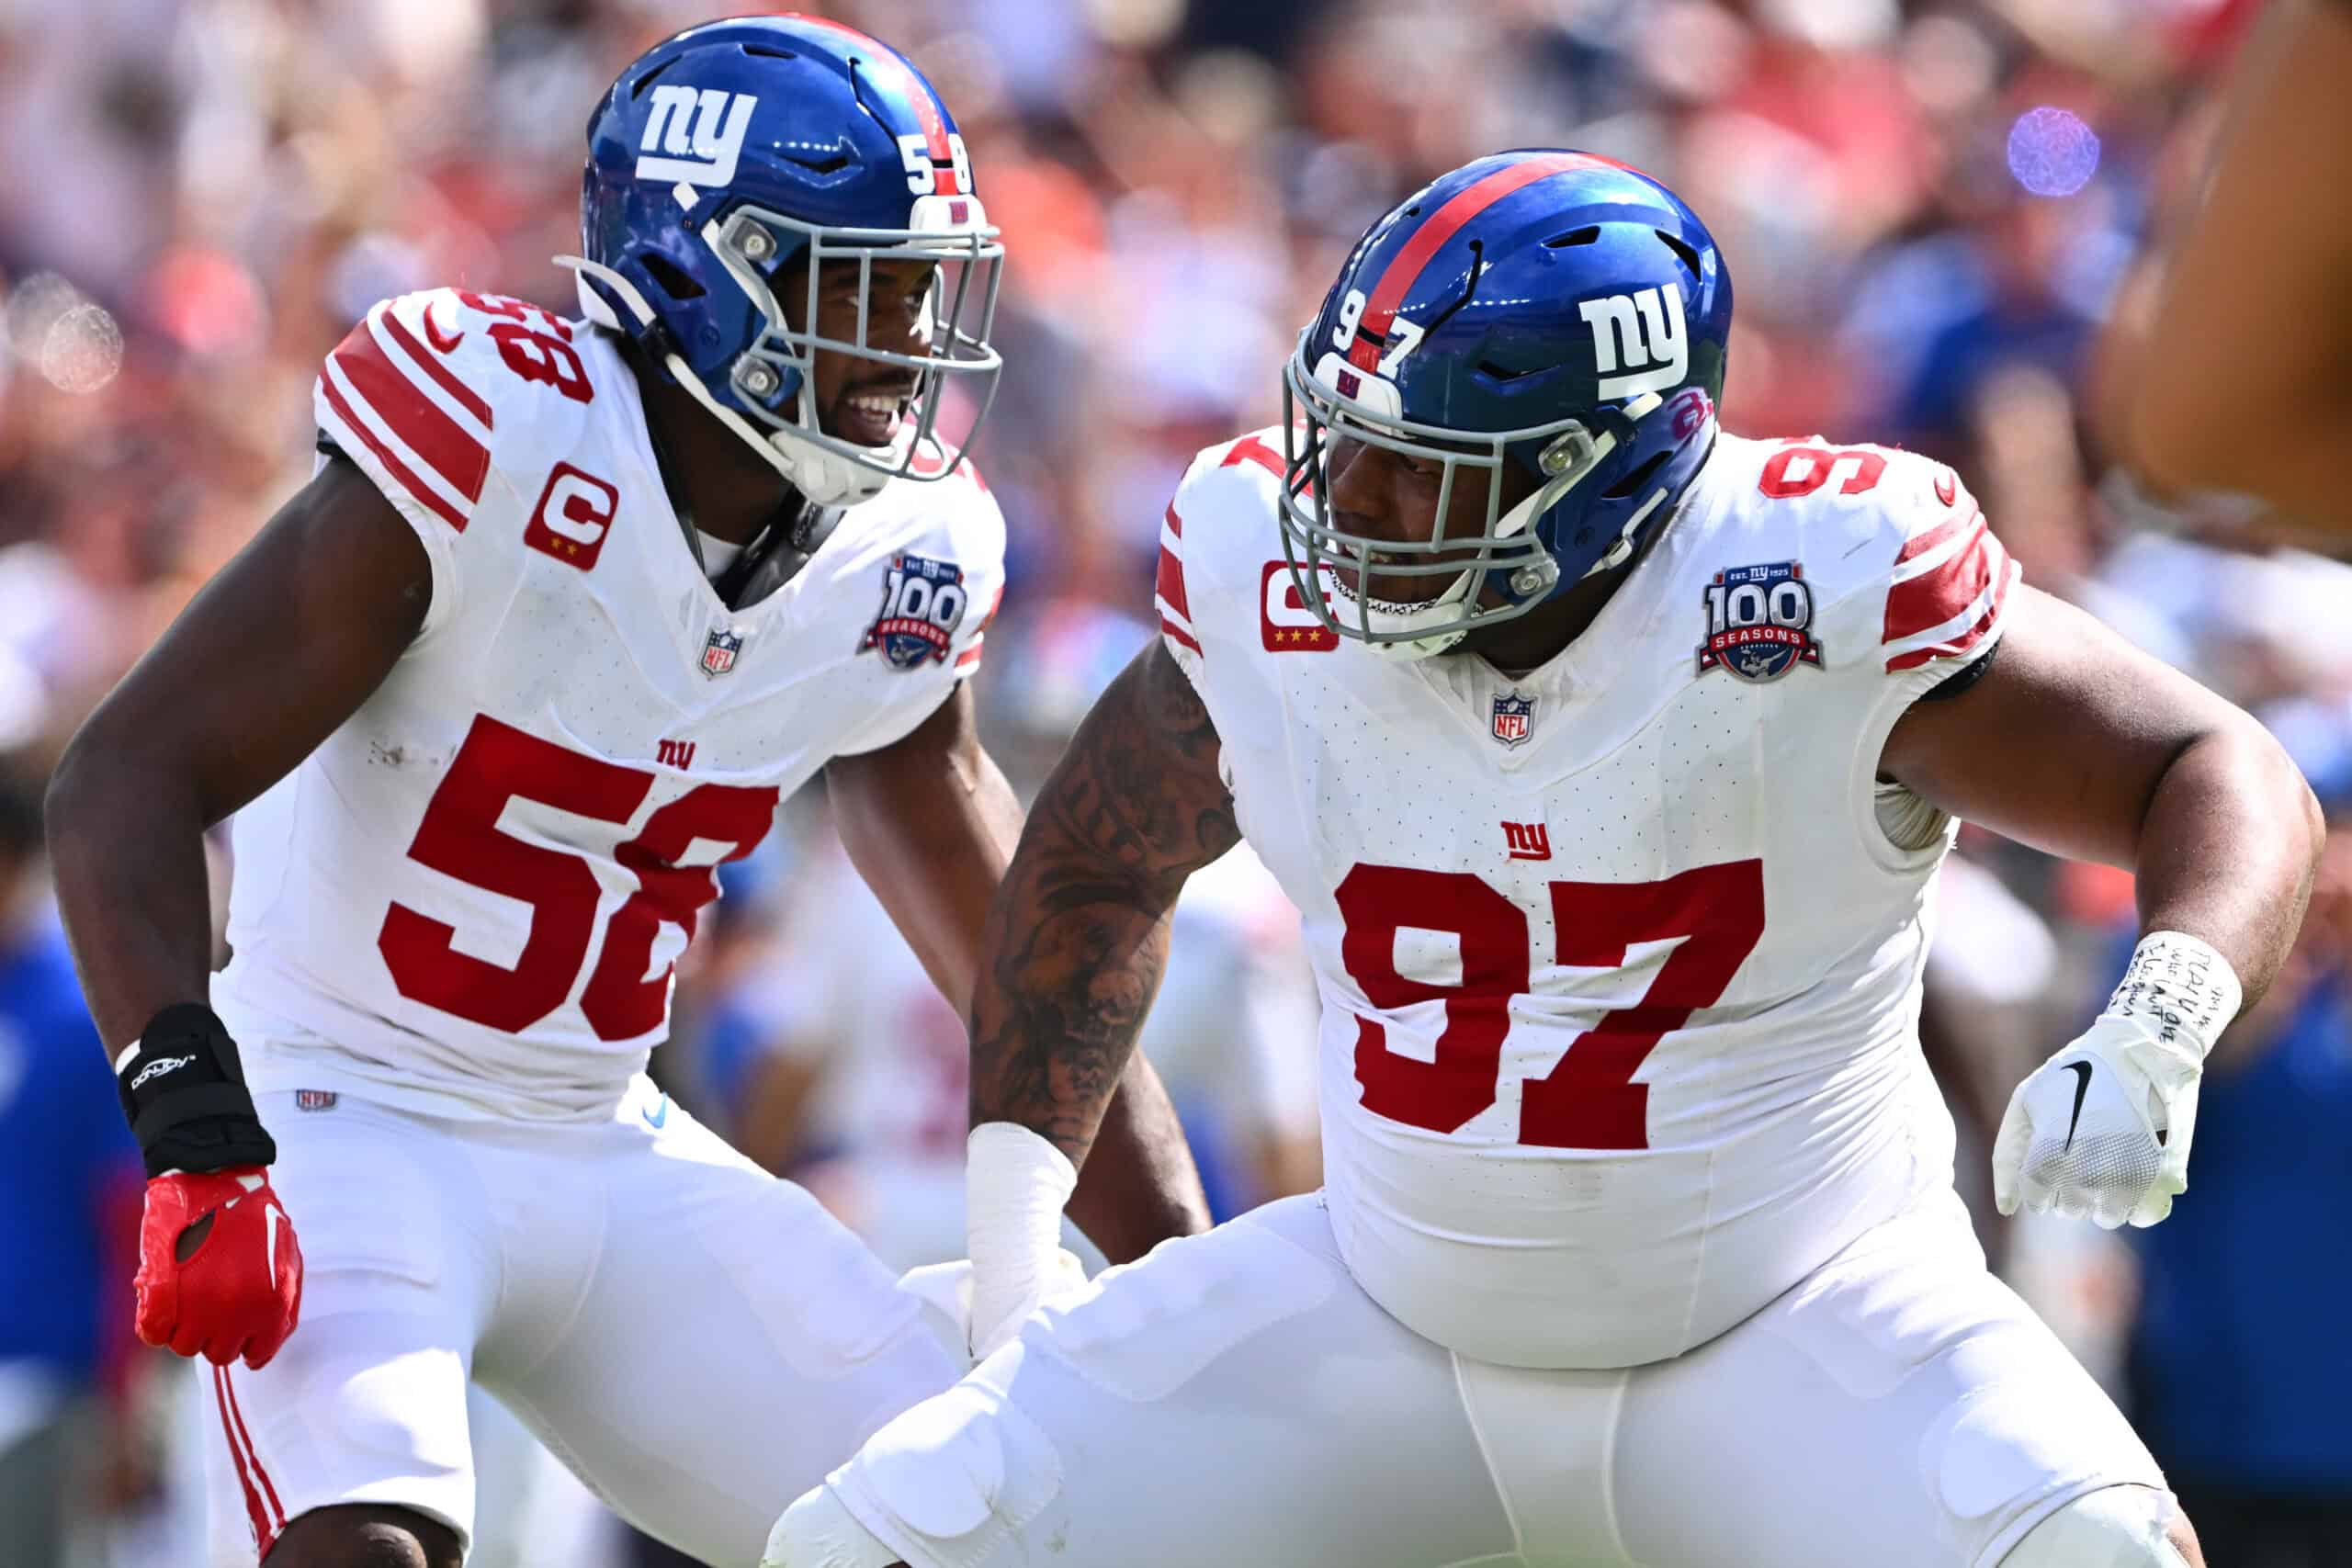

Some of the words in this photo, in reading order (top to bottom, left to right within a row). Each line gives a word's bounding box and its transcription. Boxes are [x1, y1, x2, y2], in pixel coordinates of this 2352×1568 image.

[897, 133, 972, 195] 58
[1332, 288, 1425, 380] 97
[543, 473, 611, 546] C
[881, 571, 965, 633] 100
[1707, 581, 1808, 635] 100
[1715, 628, 1800, 649] SEASONS
[1496, 715, 1525, 739] NFL
[378, 713, 780, 1042] 58
[1334, 858, 1765, 1149] 97
[131, 1056, 188, 1090] DONJOY
